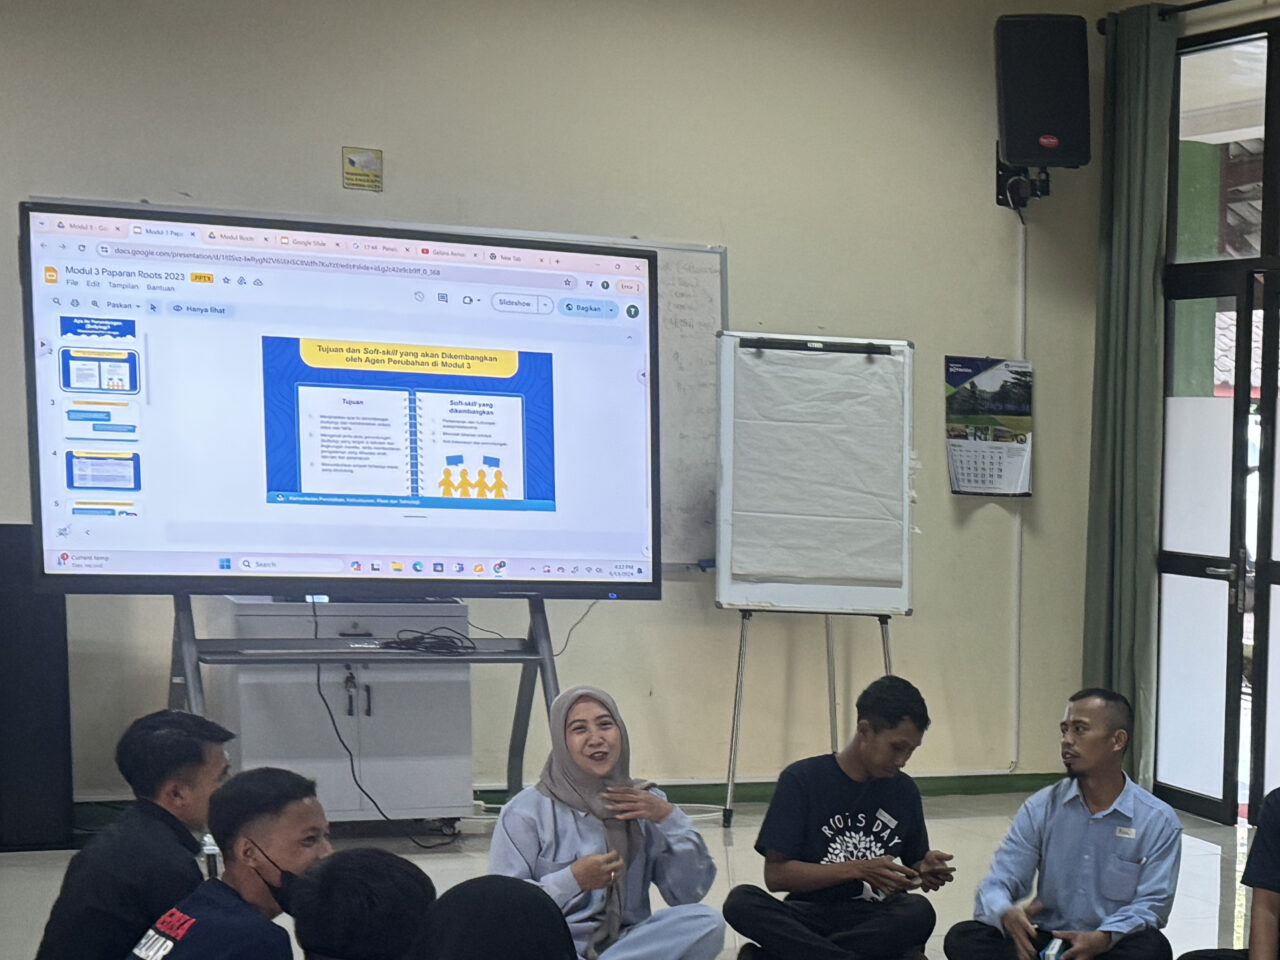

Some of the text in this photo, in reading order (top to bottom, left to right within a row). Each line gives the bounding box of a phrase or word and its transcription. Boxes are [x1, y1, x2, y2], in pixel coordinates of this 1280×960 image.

[66, 266, 93, 275] Modul
[102, 268, 136, 278] Paparan
[138, 270, 162, 279] Roots
[164, 272, 186, 281] 2023
[107, 301, 132, 309] Paskan
[186, 306, 209, 314] Hanya
[317, 344, 344, 354] Tujuan
[363, 347, 398, 356] Soft-skill
[399, 350, 419, 359] yang
[420, 350, 439, 359] akan
[441, 352, 498, 364] Dikembangkan
[364, 356, 386, 365] Agen
[388, 358, 430, 367] Perubahan
[431, 360, 439, 368] di
[441, 360, 465, 369] Modul
[872, 820, 902, 847] DAY
